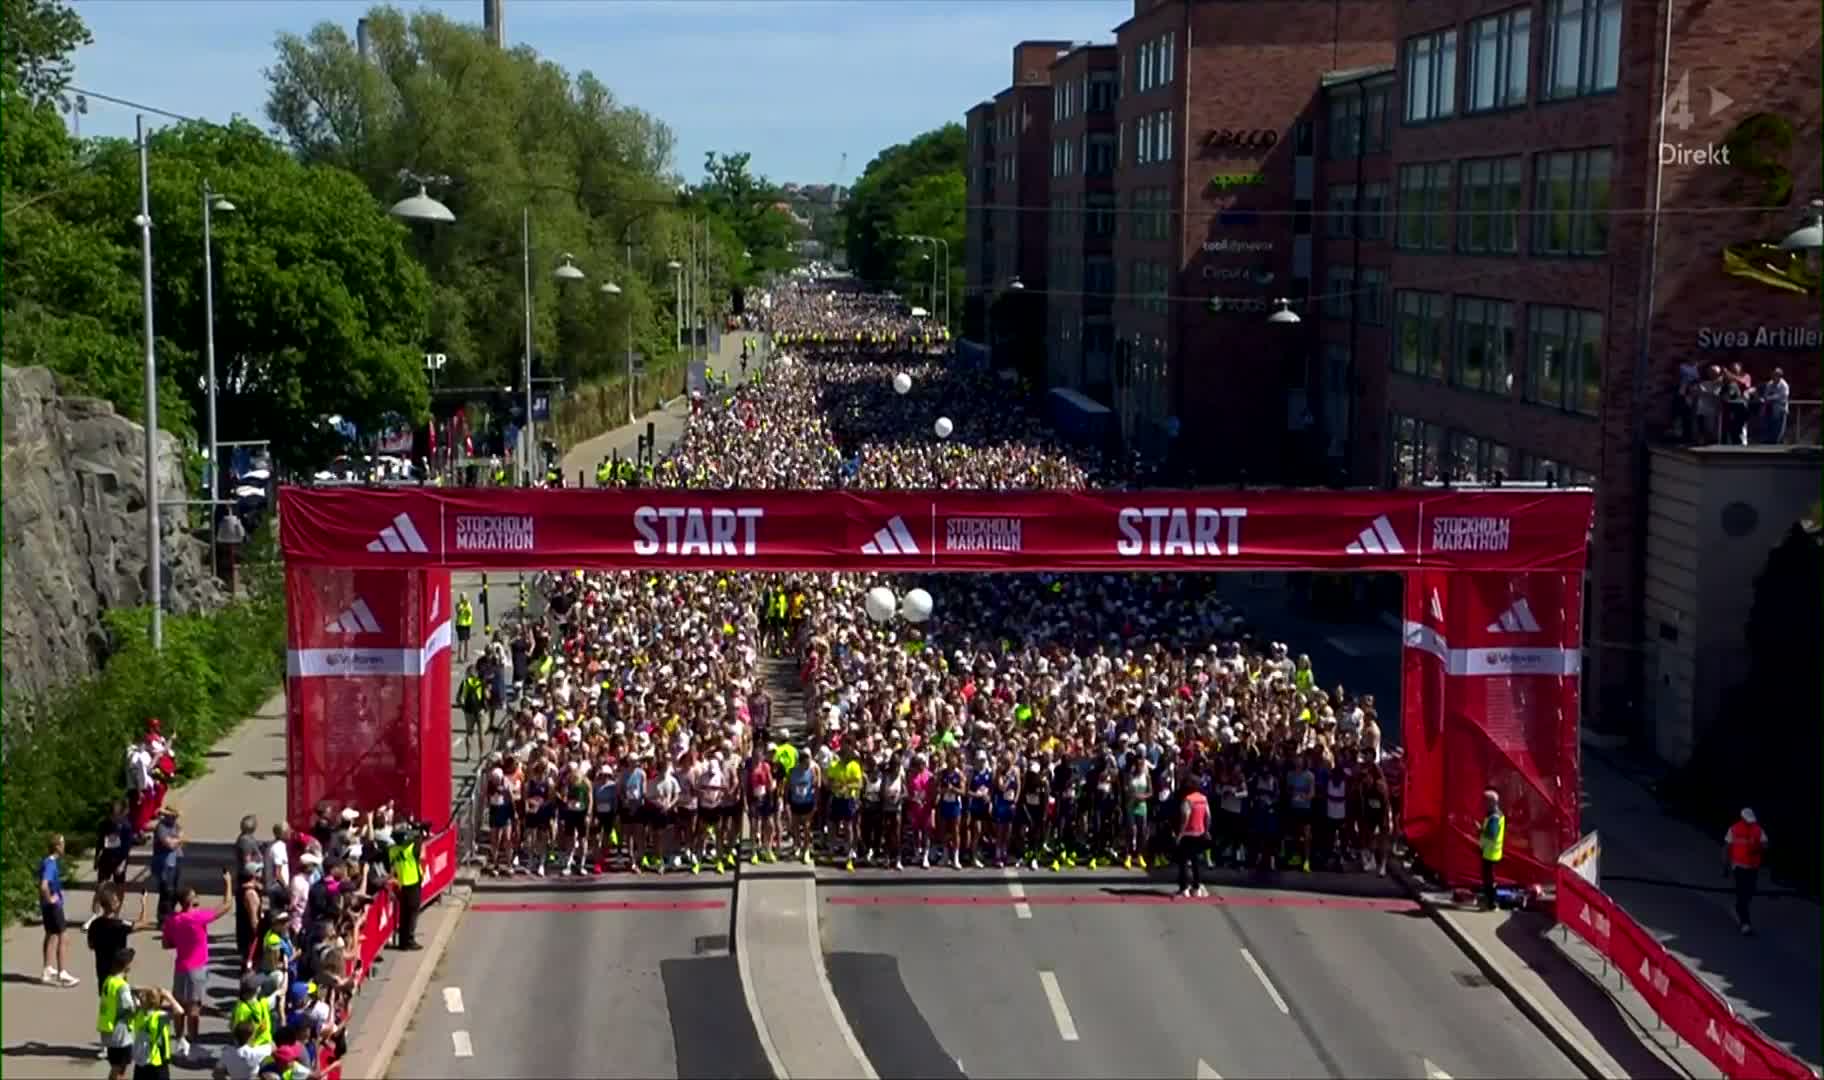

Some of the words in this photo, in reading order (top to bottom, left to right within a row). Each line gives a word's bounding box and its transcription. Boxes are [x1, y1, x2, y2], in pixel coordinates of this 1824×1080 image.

[1697, 327, 1749, 348] Svea
[456, 515, 534, 533] STOCKHOLM
[633, 506, 763, 556] START
[946, 517, 1022, 534] STOCKHOLM
[1117, 507, 1248, 556] START
[1432, 517, 1510, 534] STOCKHOLM
[456, 532, 534, 551] MARATHON
[945, 534, 1022, 551] MARATHON
[1431, 533, 1510, 551] MARATHON
